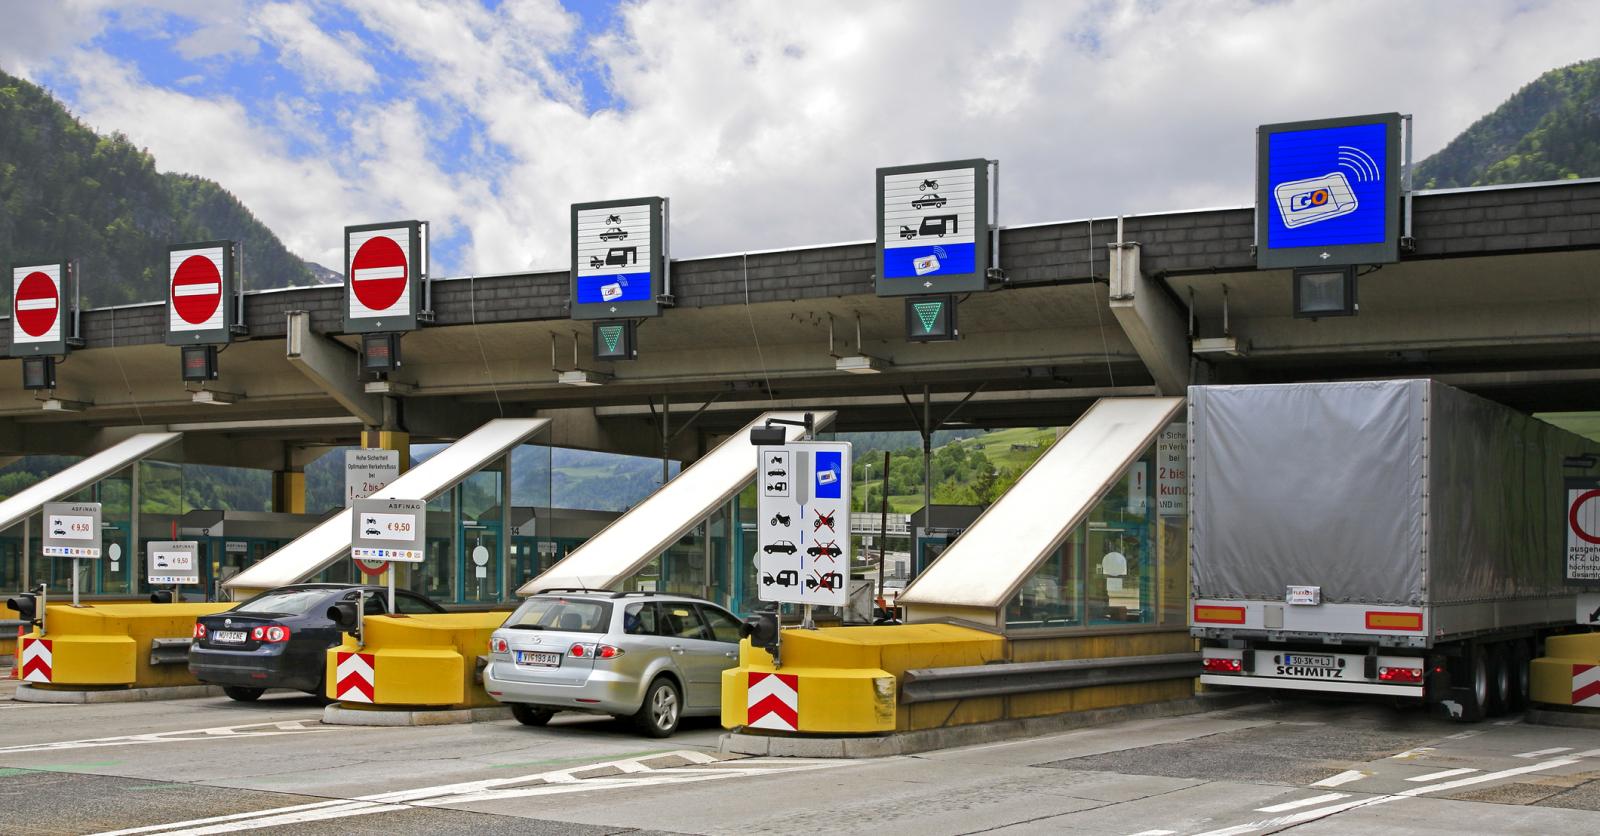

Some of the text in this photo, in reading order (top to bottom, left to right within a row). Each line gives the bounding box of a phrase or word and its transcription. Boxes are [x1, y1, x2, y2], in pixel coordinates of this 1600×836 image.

[1296, 189, 1329, 209] GO
[1170, 469, 1184, 479] bis
[77, 524, 89, 532] 9,50
[394, 522, 410, 532] 9,50
[1276, 666, 1343, 678] SCHMITZ
